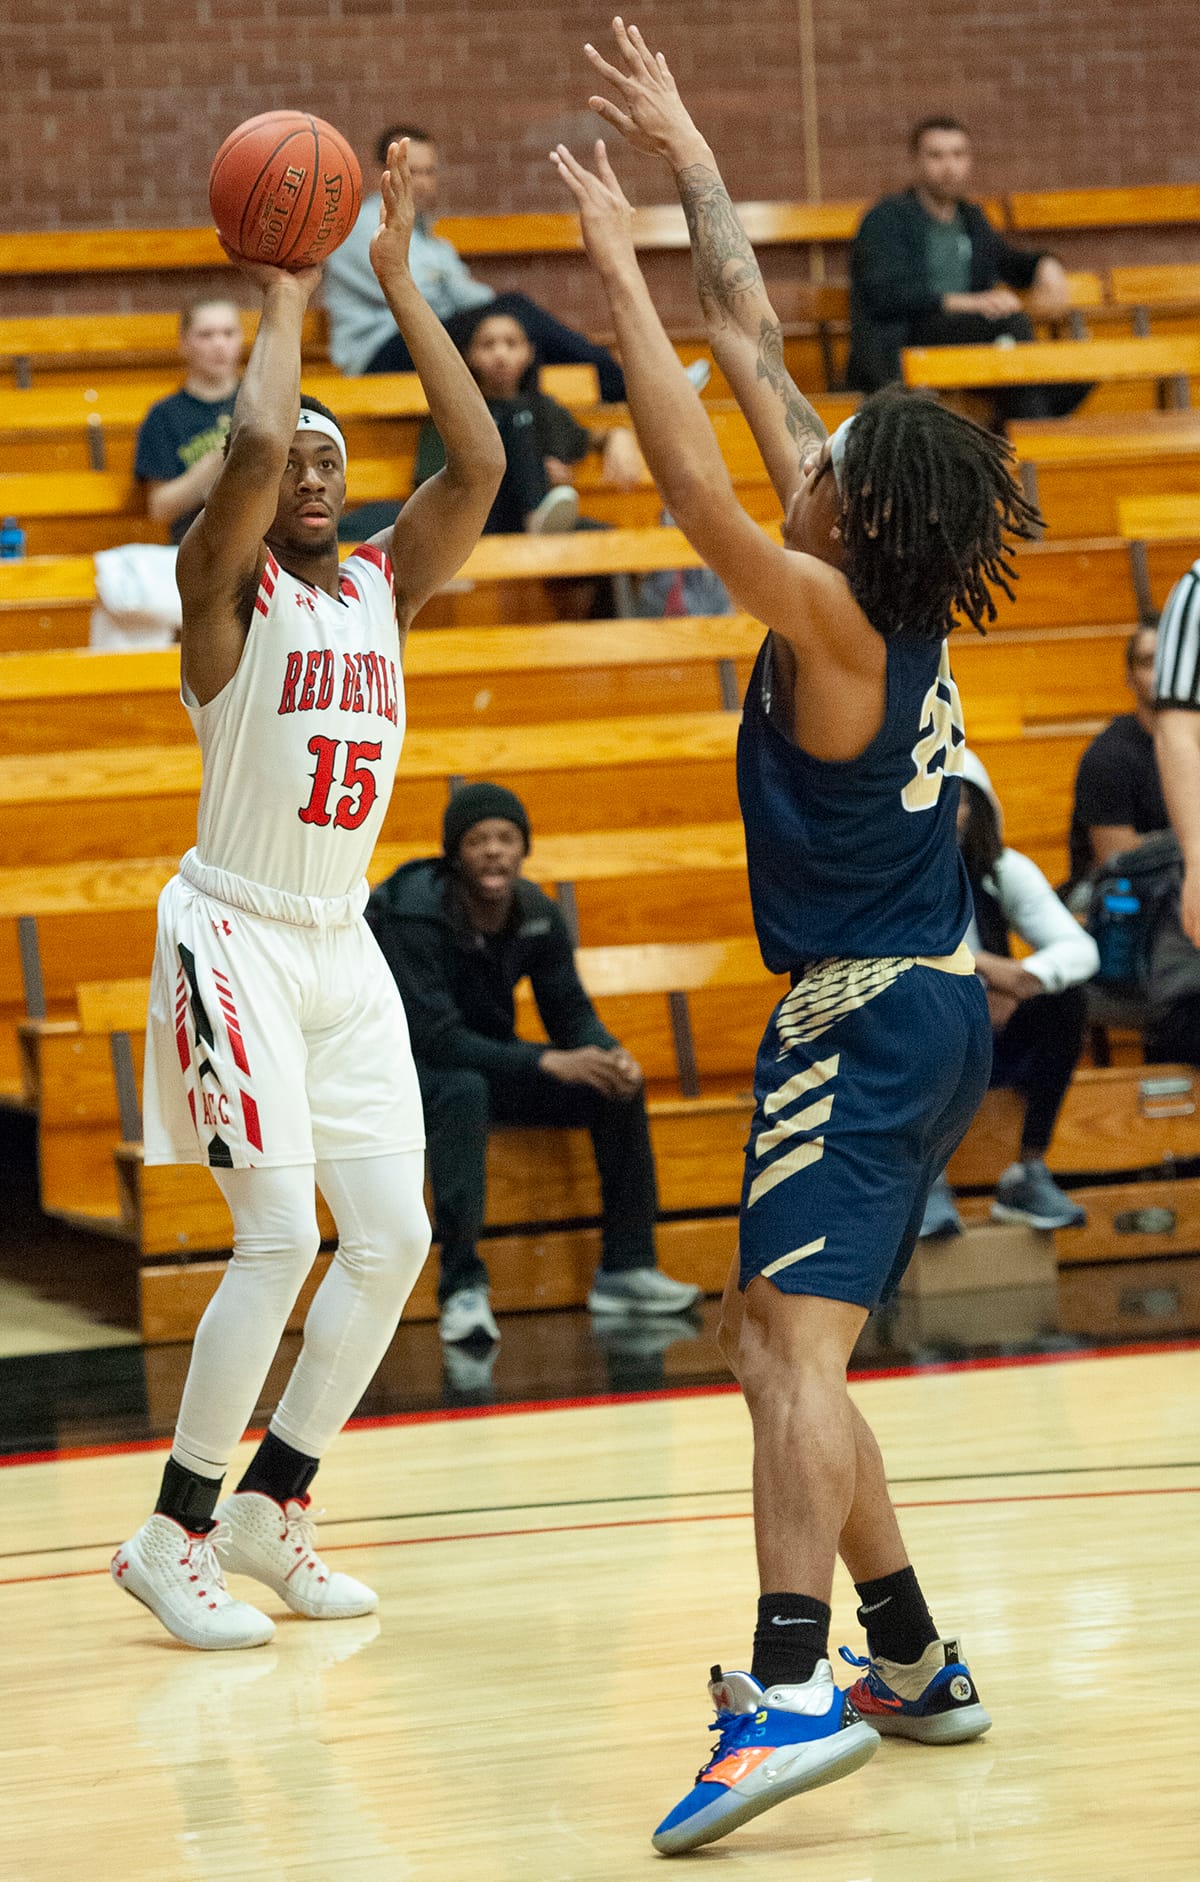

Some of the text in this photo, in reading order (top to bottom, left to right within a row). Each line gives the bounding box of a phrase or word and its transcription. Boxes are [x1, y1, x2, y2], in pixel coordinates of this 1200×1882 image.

[278, 649, 397, 728] RED DEVILS
[298, 735, 382, 830] 15
